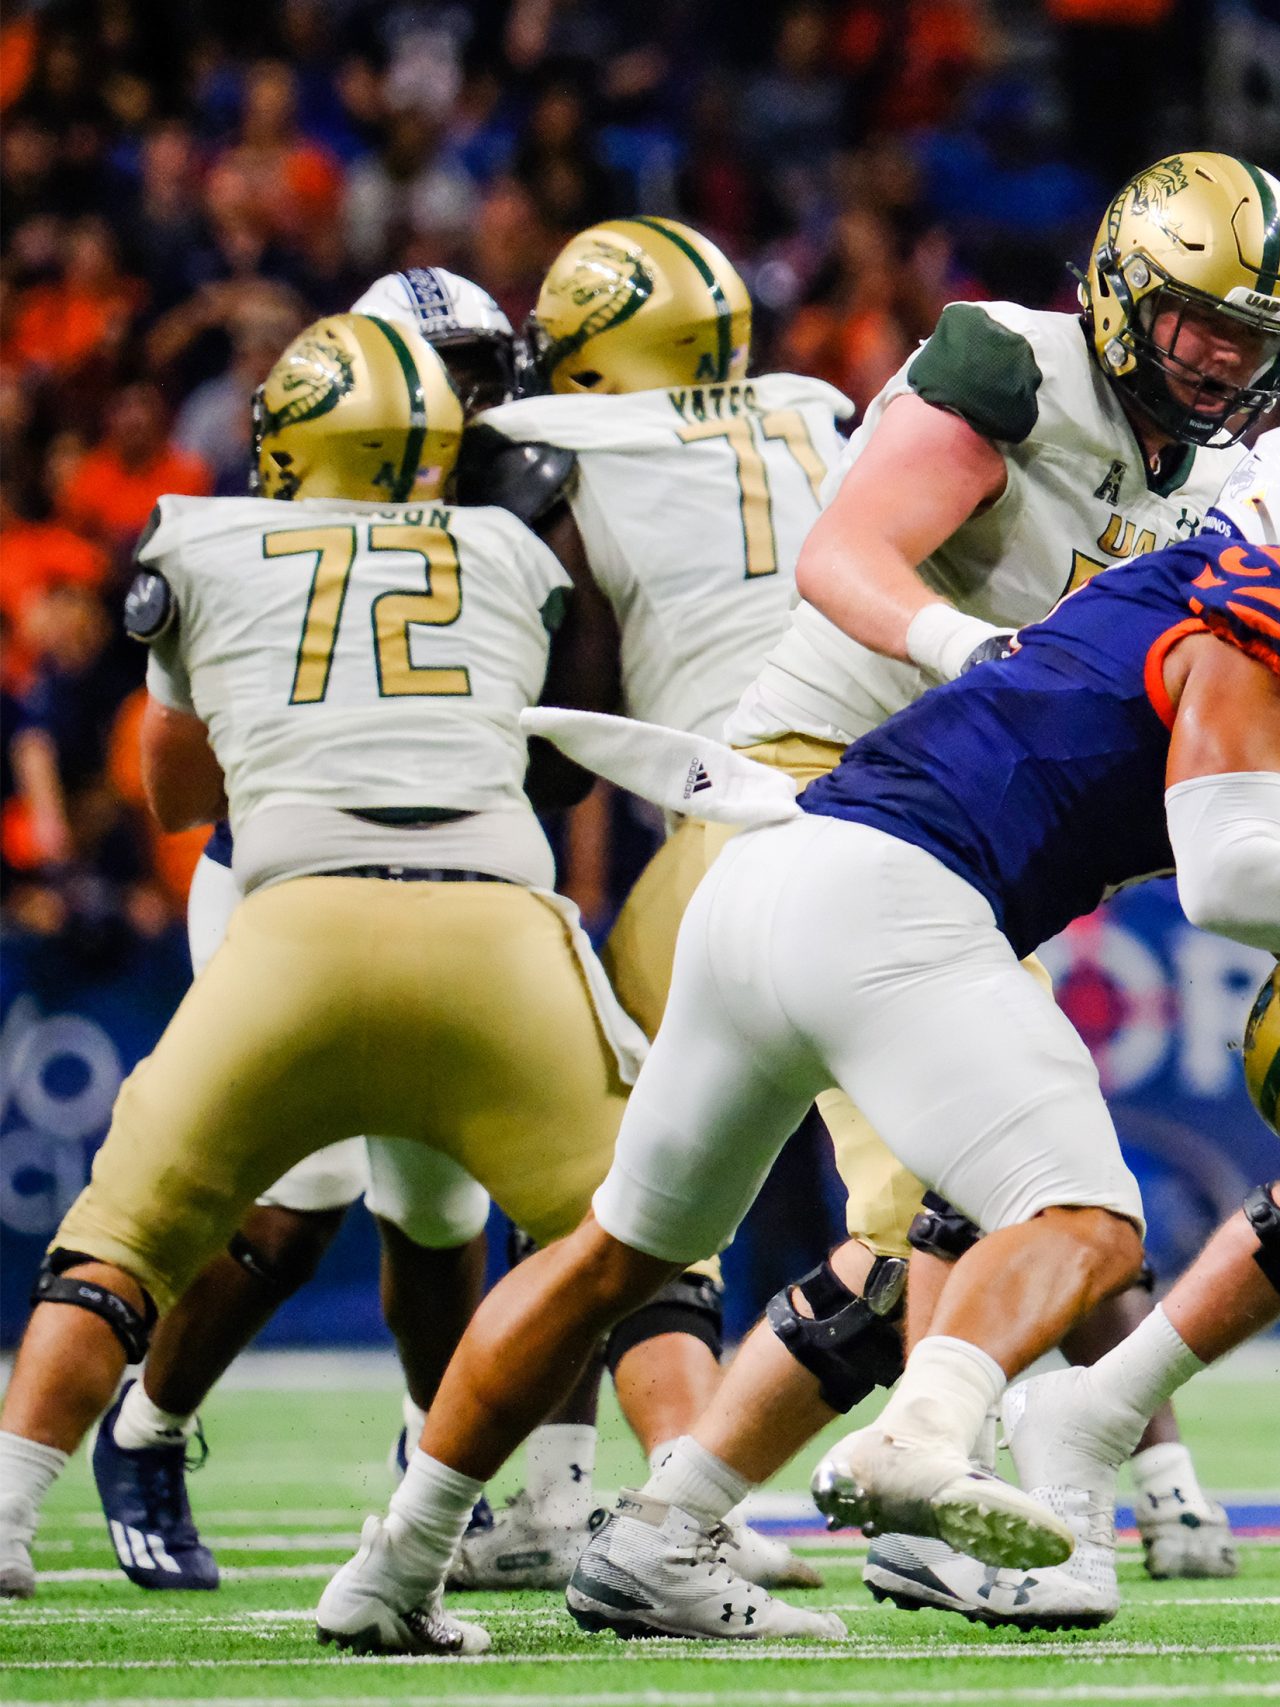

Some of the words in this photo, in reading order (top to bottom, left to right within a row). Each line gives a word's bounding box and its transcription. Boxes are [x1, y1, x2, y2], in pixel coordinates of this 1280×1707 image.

[1245, 293, 1280, 313] UAB
[1097, 512, 1174, 559] UA
[262, 523, 472, 705] 72
[683, 756, 699, 799] adidas
